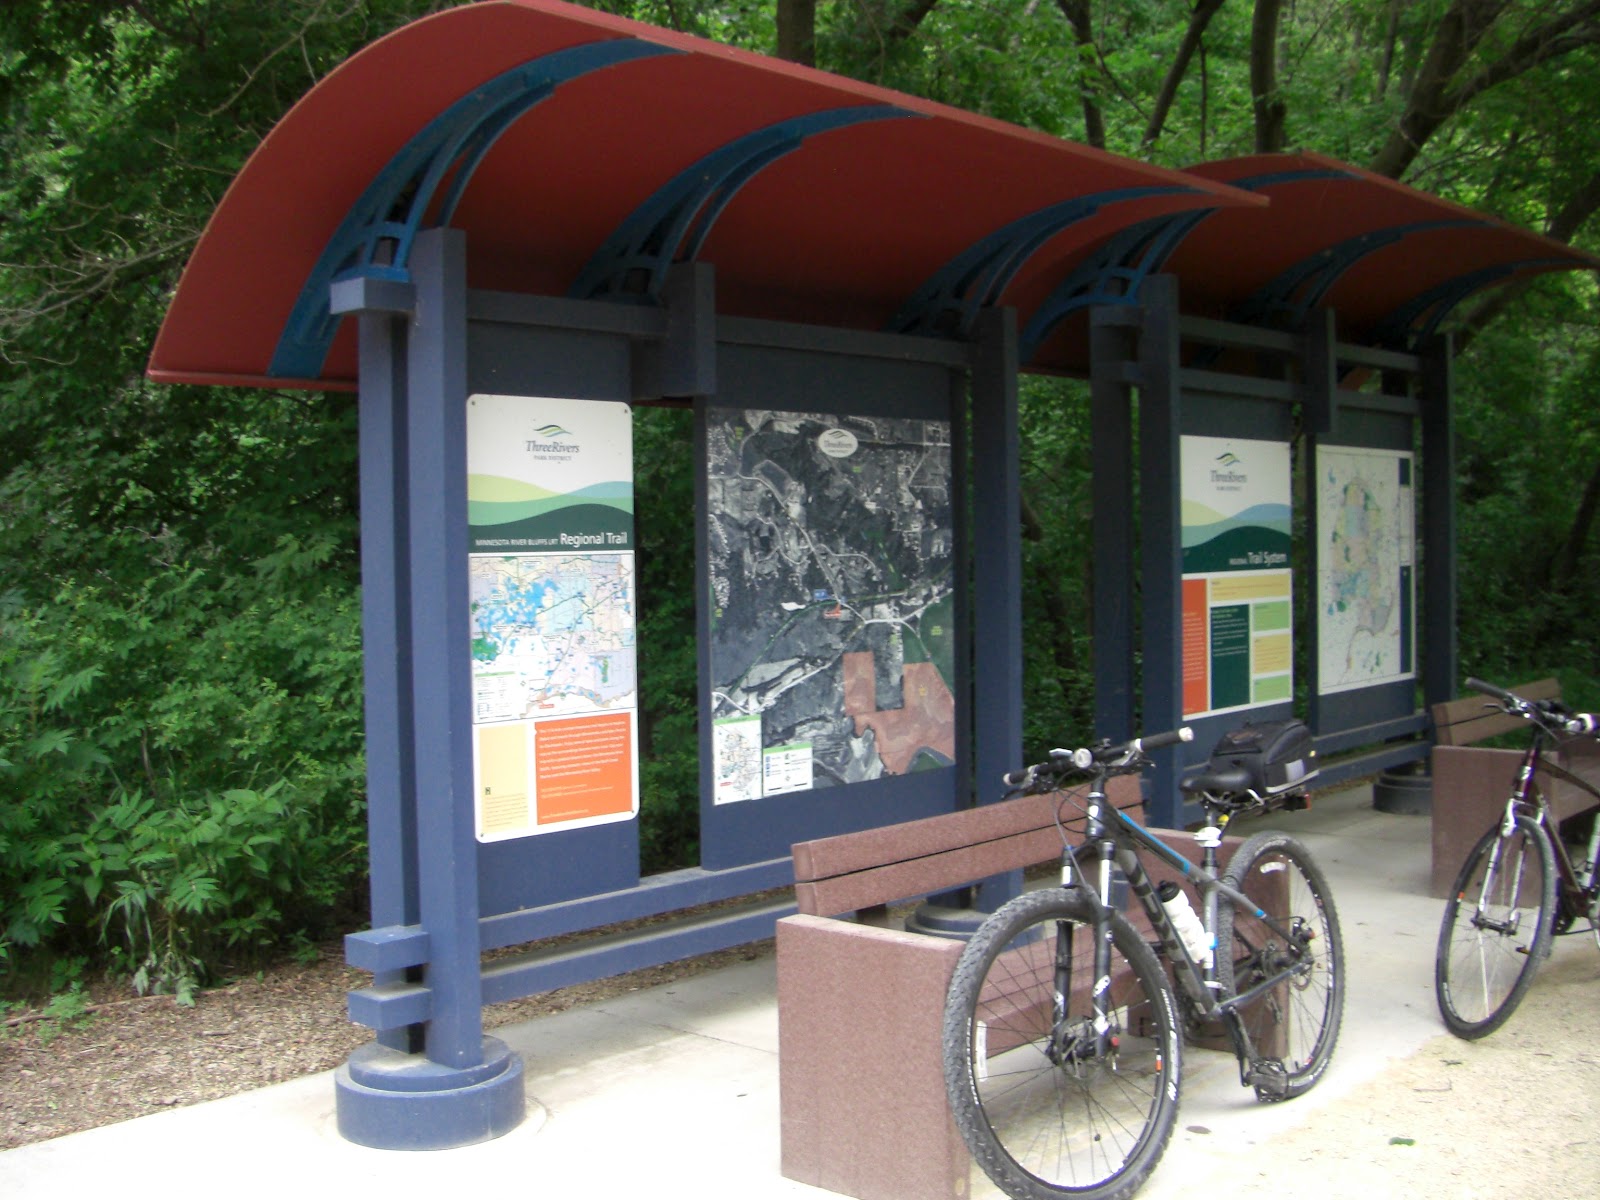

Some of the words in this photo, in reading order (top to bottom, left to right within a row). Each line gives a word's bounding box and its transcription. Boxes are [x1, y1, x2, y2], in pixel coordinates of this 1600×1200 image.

[526, 440, 580, 453] ThreeRivers
[511, 538, 527, 546] RIVER
[560, 532, 604, 547] Regional
[606, 531, 628, 544] Trail
